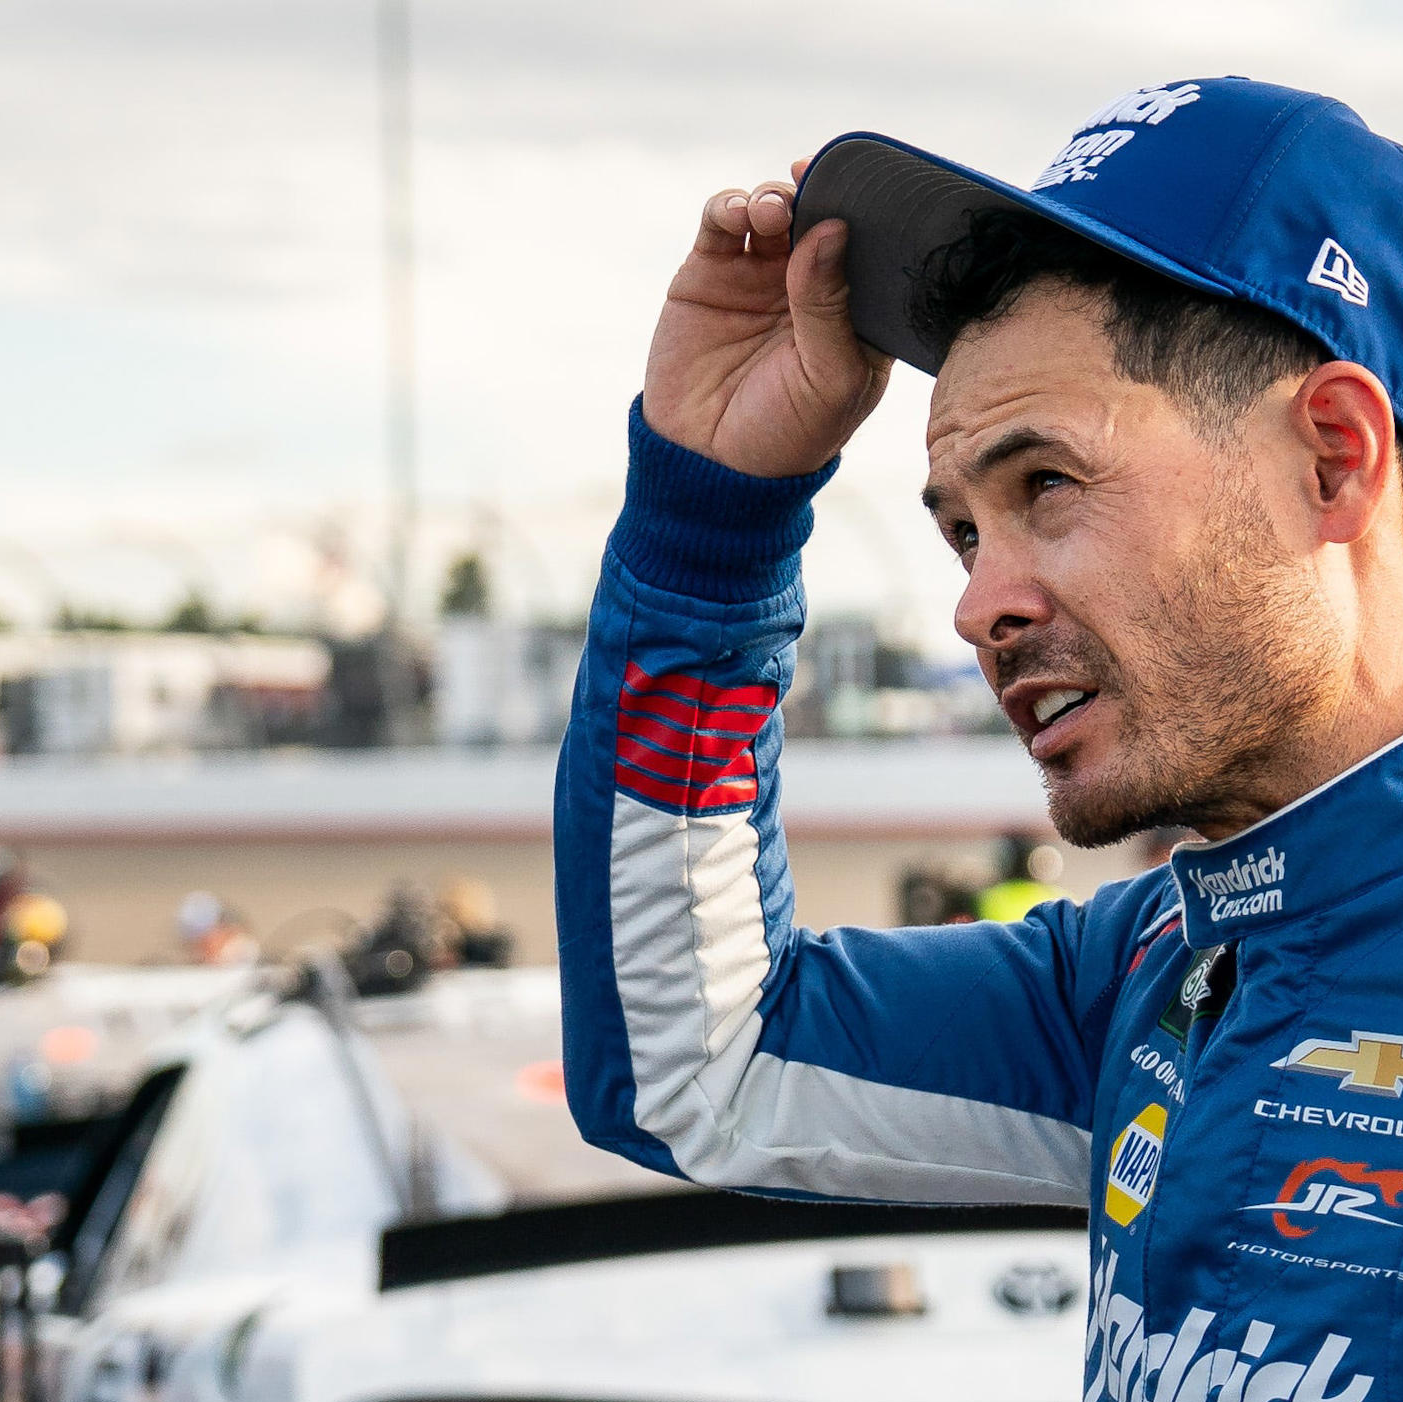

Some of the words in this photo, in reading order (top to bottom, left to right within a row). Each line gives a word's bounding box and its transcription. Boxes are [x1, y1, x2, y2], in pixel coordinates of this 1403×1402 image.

[1072, 82, 1201, 137] rick
[1054, 129, 1136, 165] com
[1188, 845, 1286, 908] Hendrick
